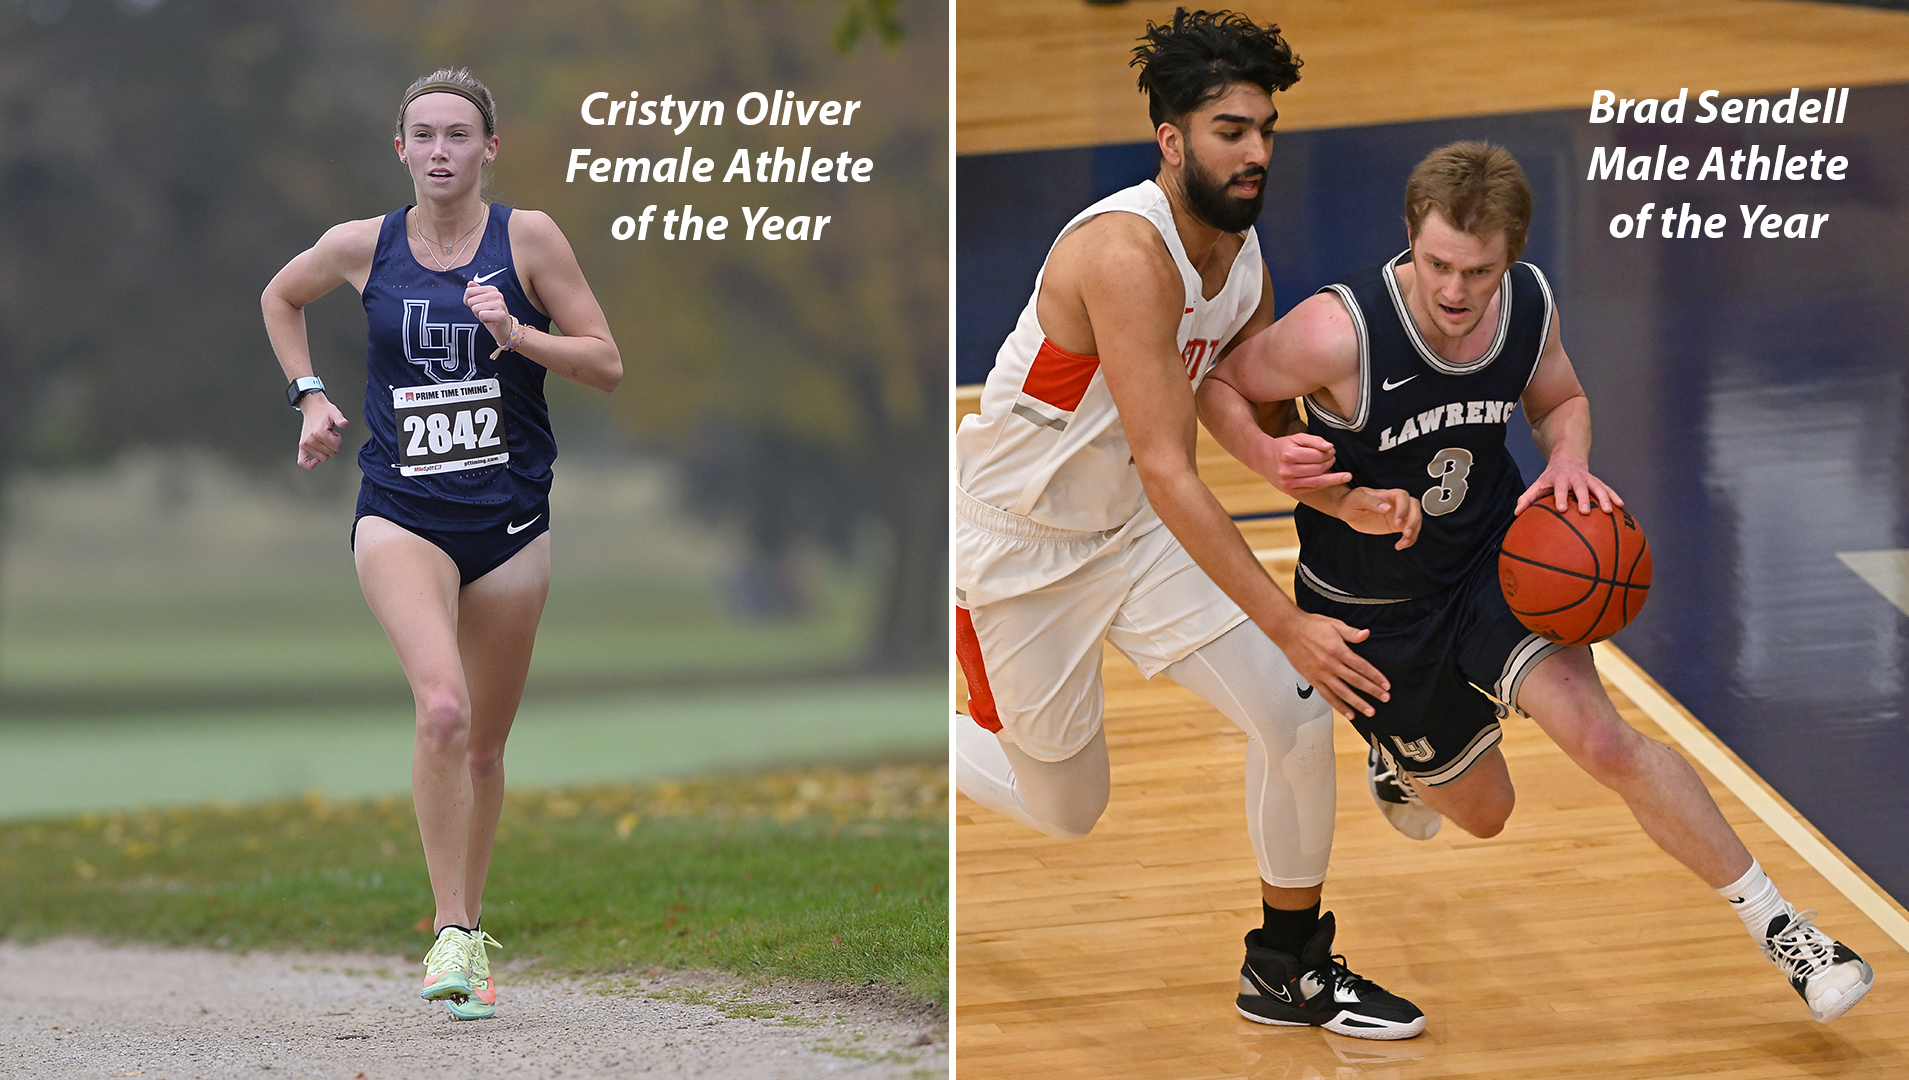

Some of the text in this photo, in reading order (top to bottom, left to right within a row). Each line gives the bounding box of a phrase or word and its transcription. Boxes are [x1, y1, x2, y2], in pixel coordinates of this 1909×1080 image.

[415, 385, 489, 401] PRIME TIME TIMING
[403, 407, 501, 457] 2842
[1421, 447, 1475, 517] 3
